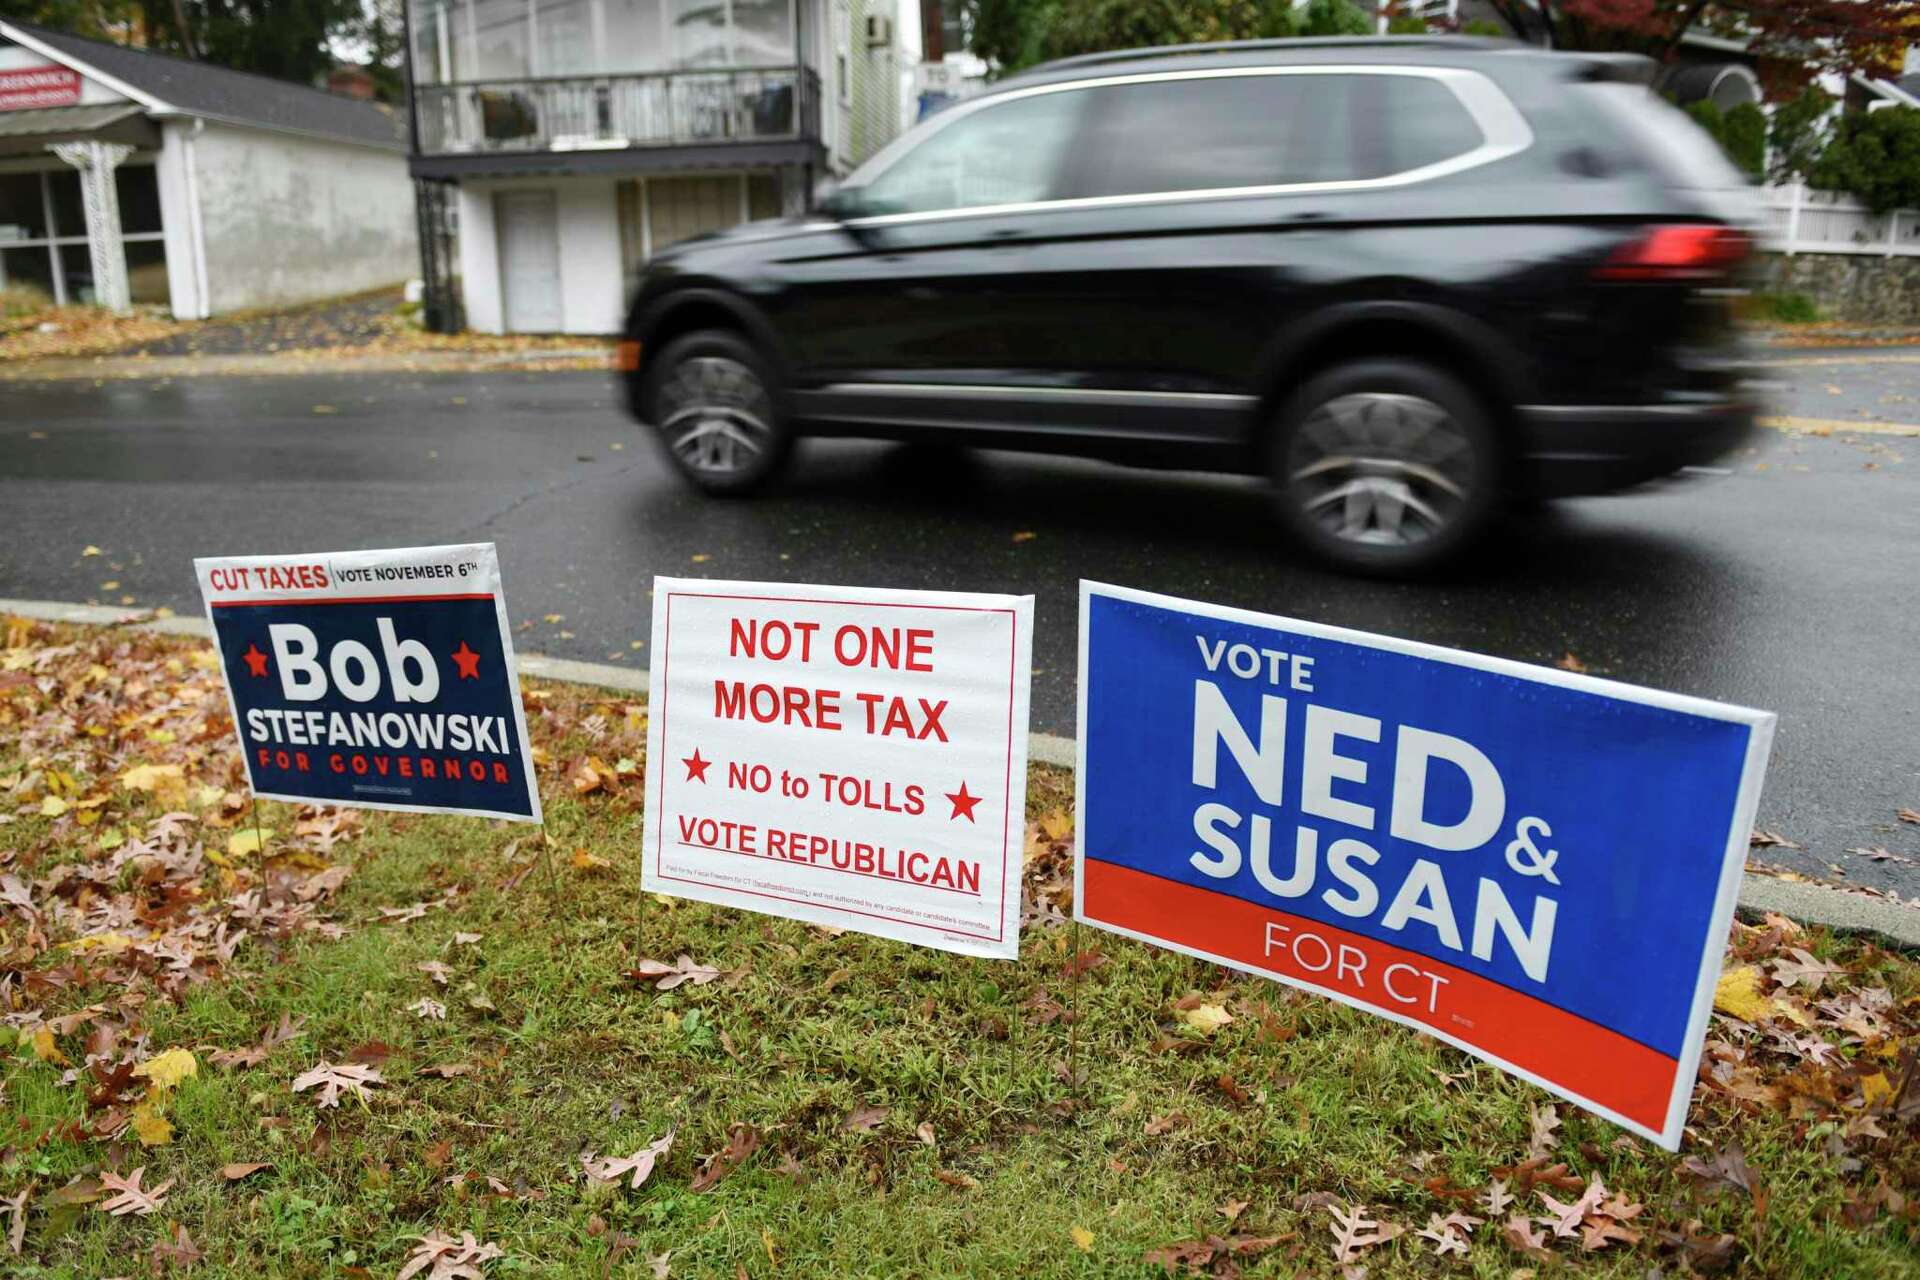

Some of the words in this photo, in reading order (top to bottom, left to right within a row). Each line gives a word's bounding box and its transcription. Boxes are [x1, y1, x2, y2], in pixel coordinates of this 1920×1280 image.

[210, 568, 249, 592] CUT
[255, 564, 329, 590] TAXES
[336, 568, 373, 583] VOTE
[375, 564, 454, 581] NOVEMBER
[457, 561, 479, 577] 6TH
[268, 617, 440, 703] Bob
[729, 617, 821, 663] NOT
[833, 623, 935, 673] ONE
[1196, 635, 1315, 693] VOTE
[246, 708, 511, 755] STEFANOWSKI
[714, 679, 843, 731] MORE
[855, 692, 950, 744] TAX
[258, 748, 311, 771] FOR
[329, 753, 510, 784] GOVERNOR
[728, 761, 772, 794] NO
[781, 770, 810, 799] to
[818, 772, 926, 817] TOLLS
[1192, 679, 1506, 852] NED
[1504, 816, 1561, 886] &
[678, 815, 757, 855] VOTE
[766, 828, 981, 893] REPUBLICAN
[1189, 802, 1559, 984] SUSAN
[1265, 922, 1367, 988] FOR
[1383, 962, 1450, 1014] CT
